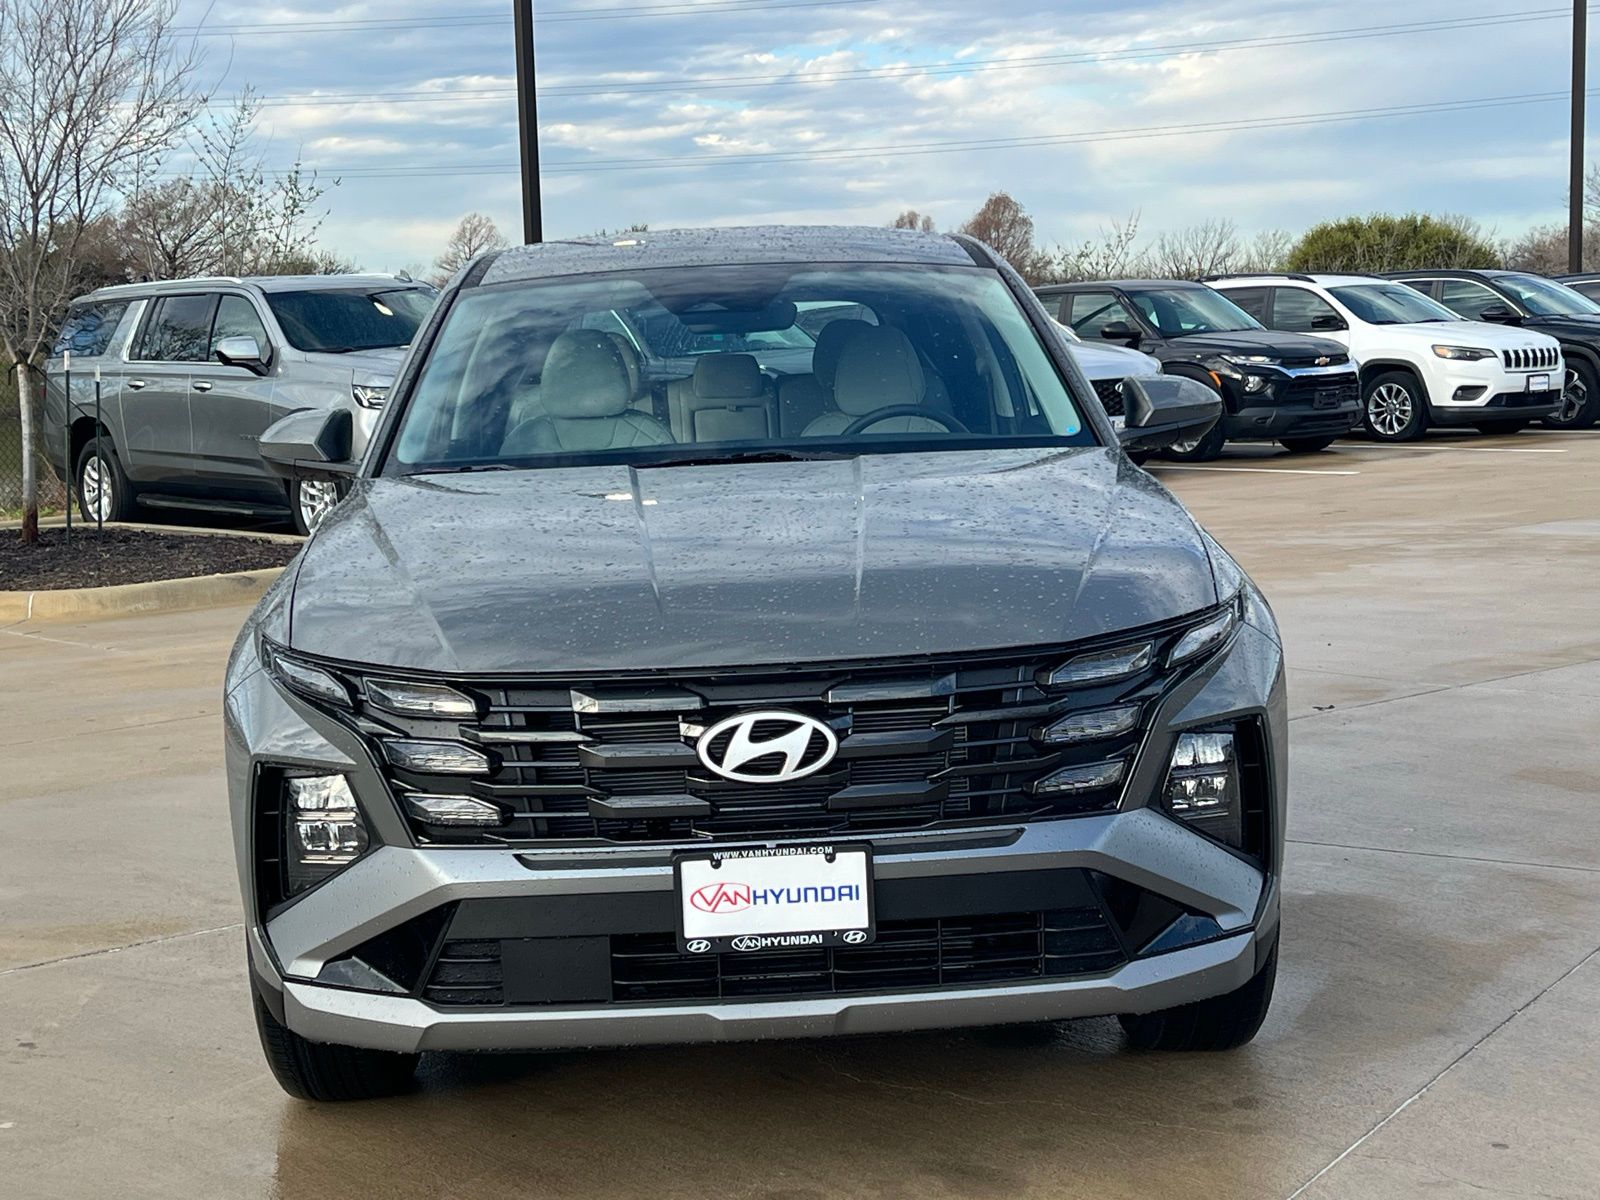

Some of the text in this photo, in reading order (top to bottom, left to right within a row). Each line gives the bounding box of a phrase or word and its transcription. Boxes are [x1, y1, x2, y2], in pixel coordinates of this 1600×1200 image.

[712, 846, 833, 860] WWW.VANHYUNDAI.COM
[694, 883, 860, 912] VAN HYUNDAI
[761, 934, 823, 947] HYUNDAI
